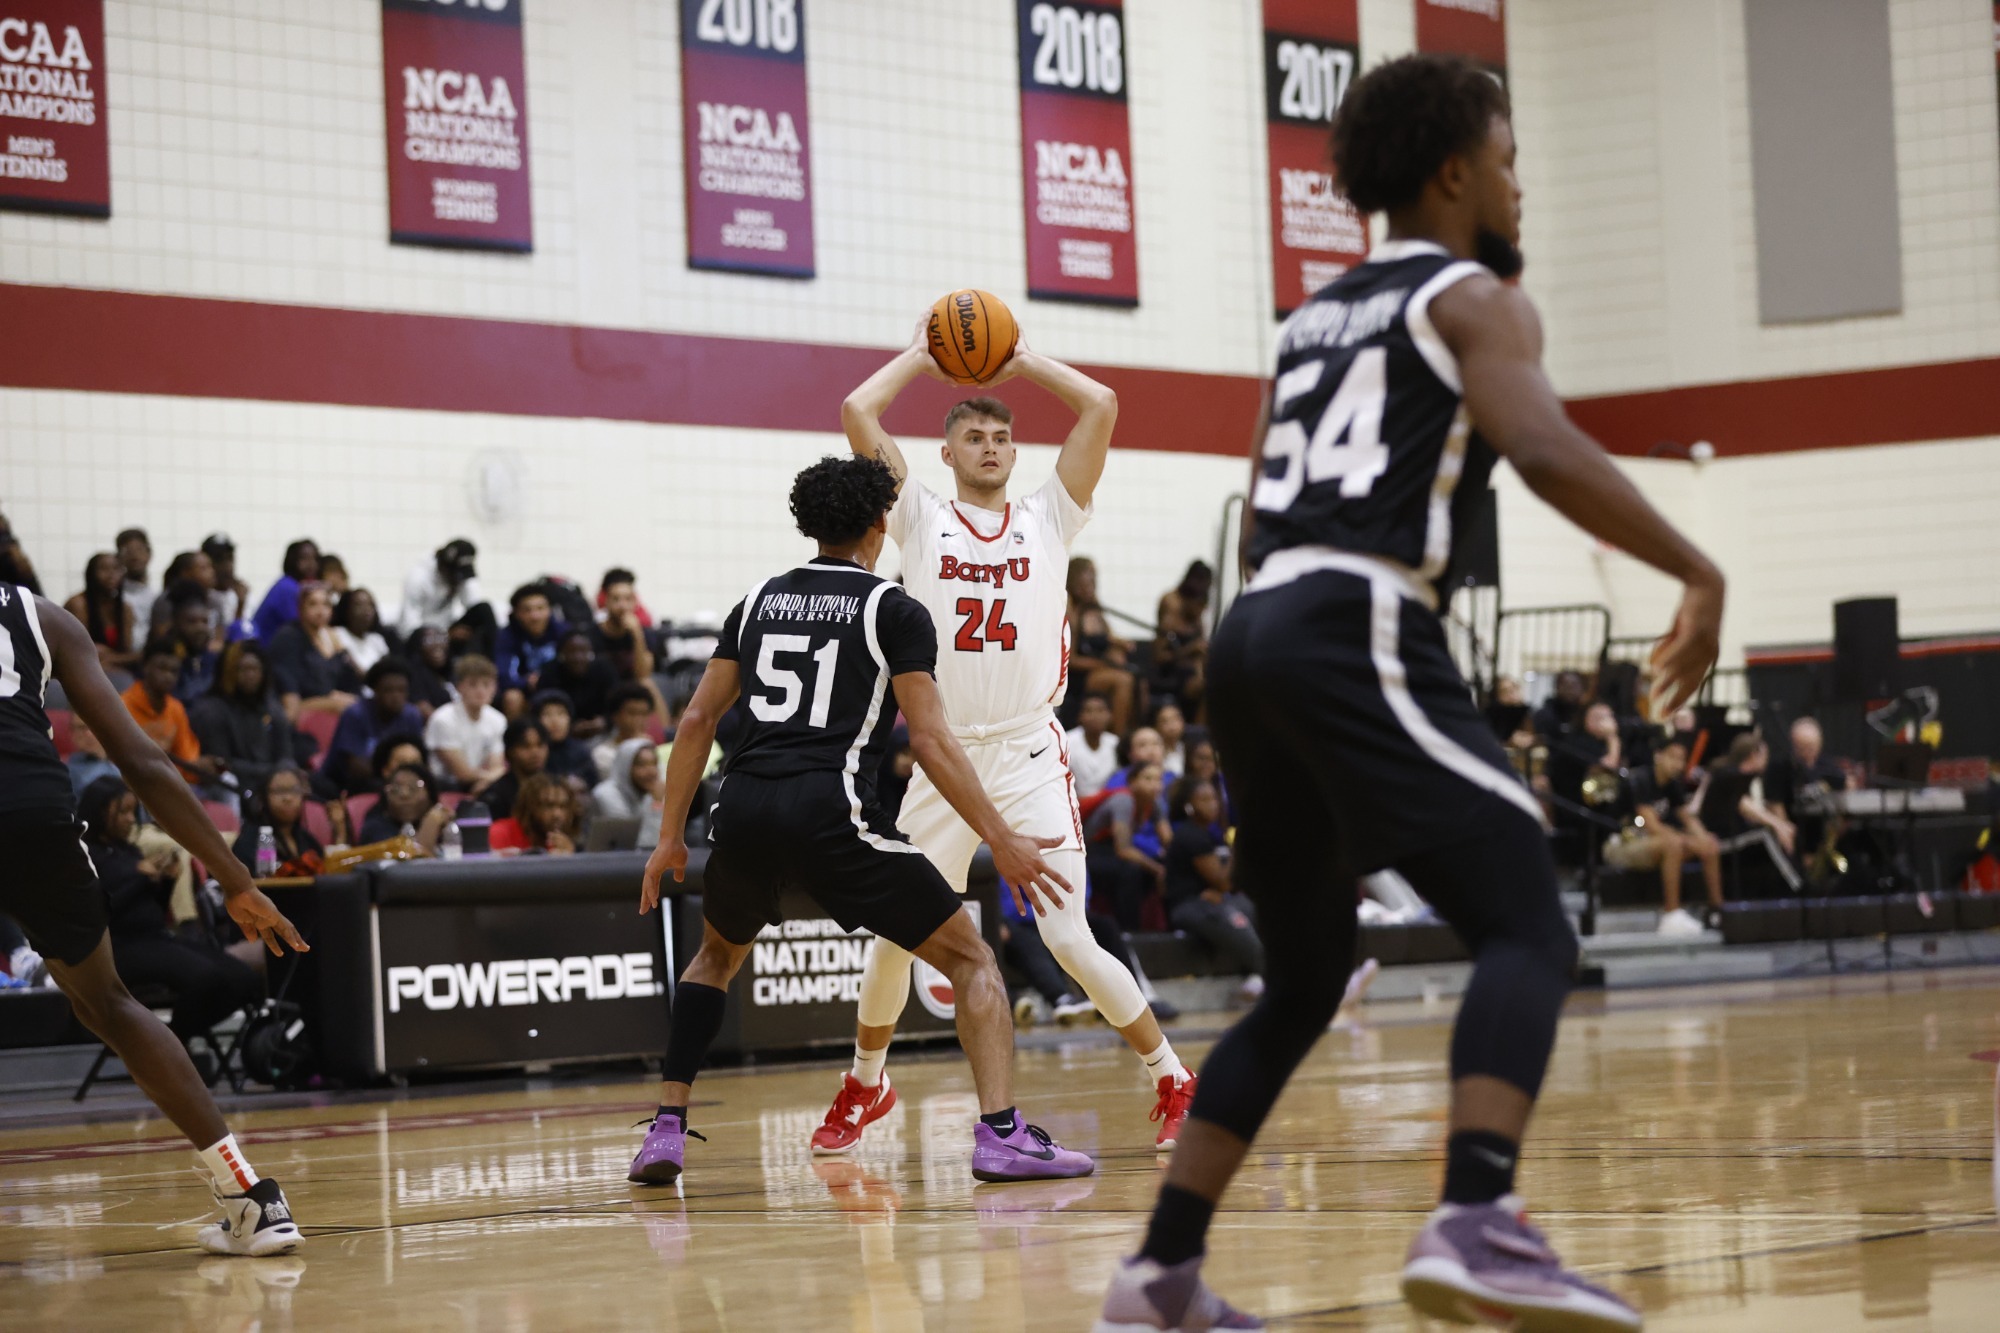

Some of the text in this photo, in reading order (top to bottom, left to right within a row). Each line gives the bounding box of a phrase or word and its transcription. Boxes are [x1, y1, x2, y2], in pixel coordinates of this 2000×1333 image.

[0, 17, 92, 71] CAA
[1031, 3, 1122, 94] 2018
[0, 63, 95, 100] TIONAL
[403, 66, 518, 119] NCAA
[1278, 40, 1353, 123] 2017
[0, 91, 96, 126] AMPIONS
[404, 110, 520, 146] NATIONAL
[698, 102, 803, 154] NCAA
[404, 137, 522, 171] CHAMPIONS
[700, 143, 804, 178] NATIONAL
[1035, 140, 1128, 189] NCAA
[699, 169, 806, 202] CHAMPIONS
[955, 293, 977, 353] Wilson
[1253, 345, 1390, 513] 54
[757, 610, 856, 625] UNIVERSITY
[760, 593, 860, 615] FLORIDA NATIONAL
[954, 597, 1018, 653] 24
[749, 633, 840, 729] 51
[752, 938, 875, 975] NATION
